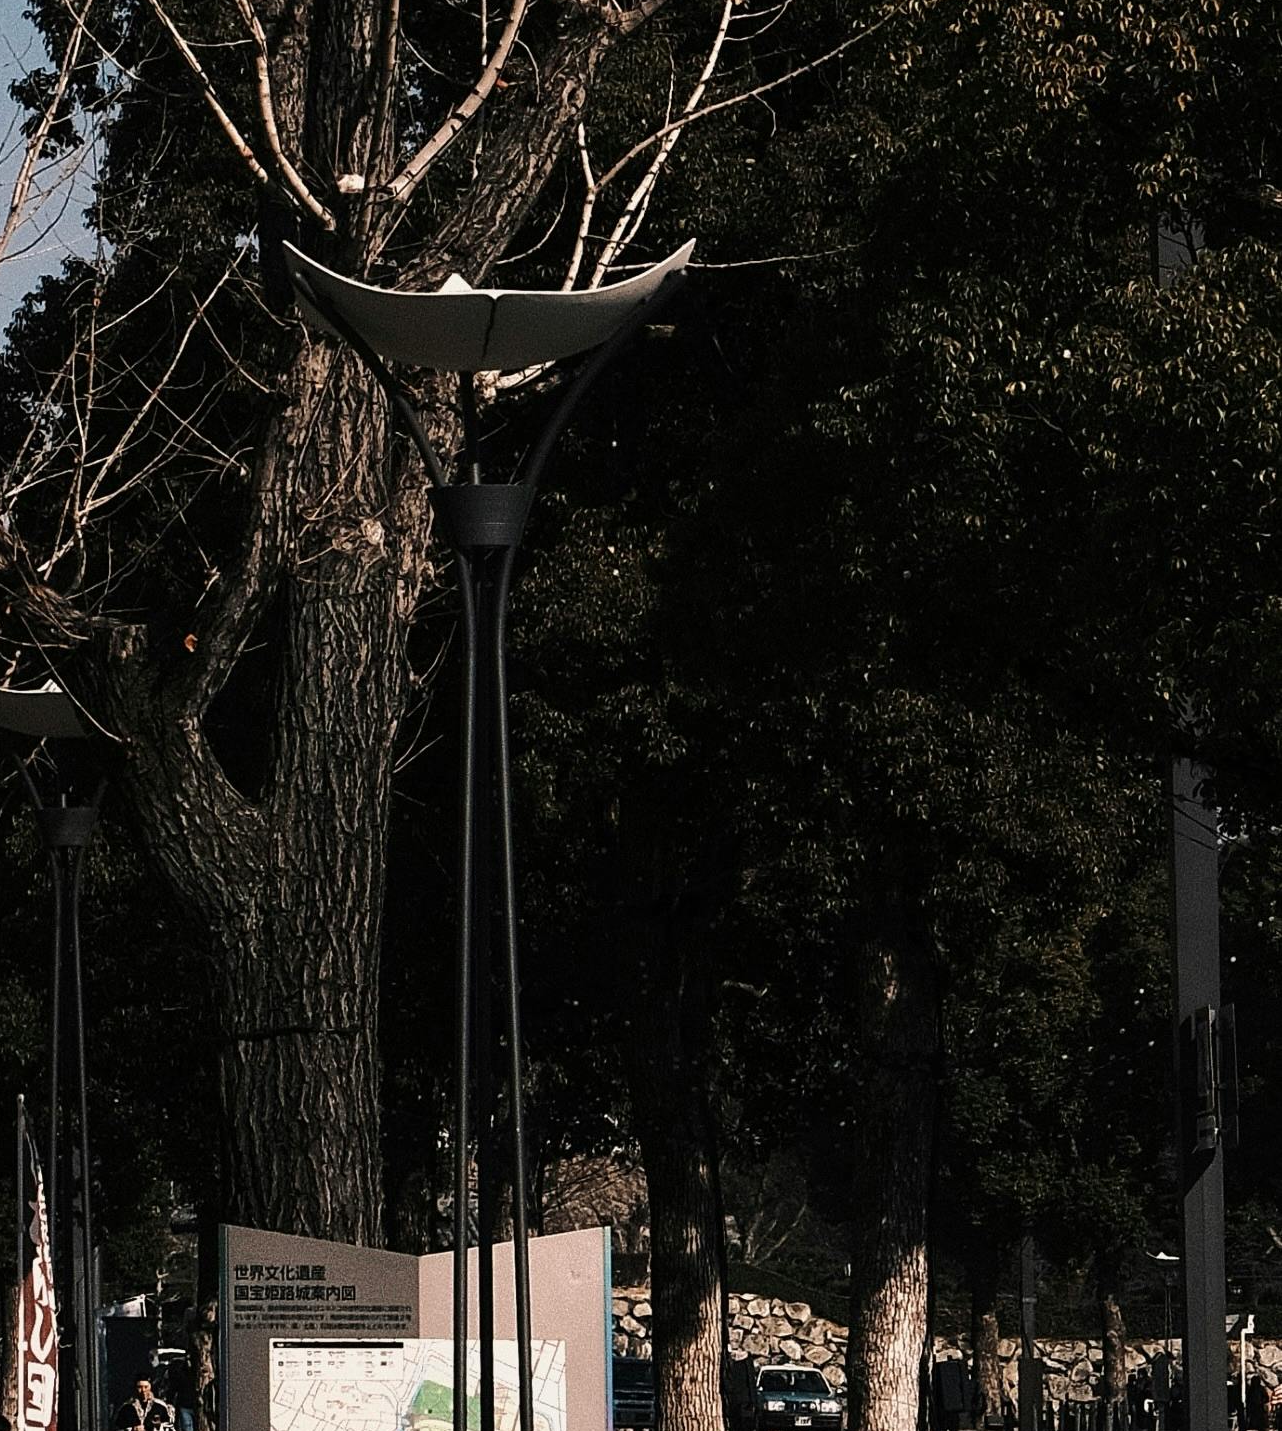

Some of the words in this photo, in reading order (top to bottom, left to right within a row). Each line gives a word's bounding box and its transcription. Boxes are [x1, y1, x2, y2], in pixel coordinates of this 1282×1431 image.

[235, 1265, 326, 1281] 世界文化遺産
